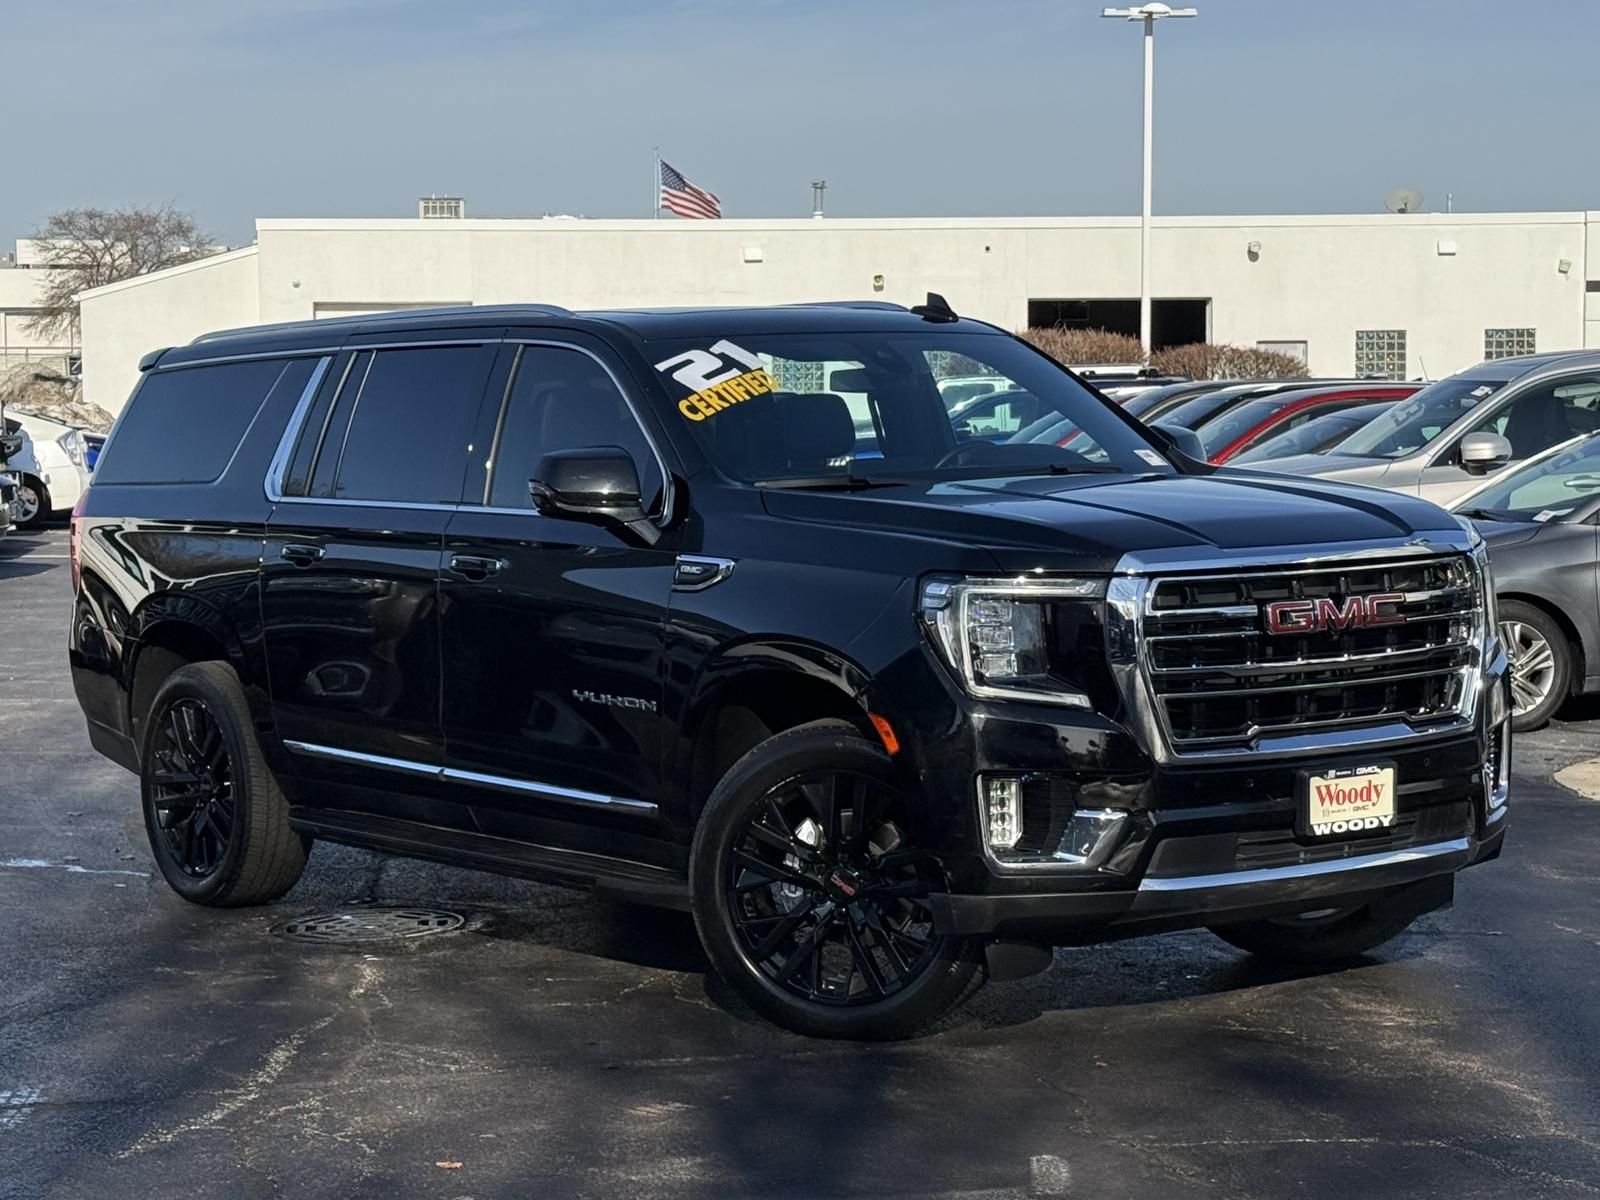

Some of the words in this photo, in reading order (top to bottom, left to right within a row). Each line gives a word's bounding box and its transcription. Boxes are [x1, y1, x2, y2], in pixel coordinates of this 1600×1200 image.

[654, 339, 763, 393] 21
[678, 367, 779, 422] CERTIFIED
[1266, 592, 1406, 635] GMC
[572, 689, 657, 712] YUKON
[1315, 779, 1385, 807] Woody
[1312, 815, 1394, 836] WOODY
